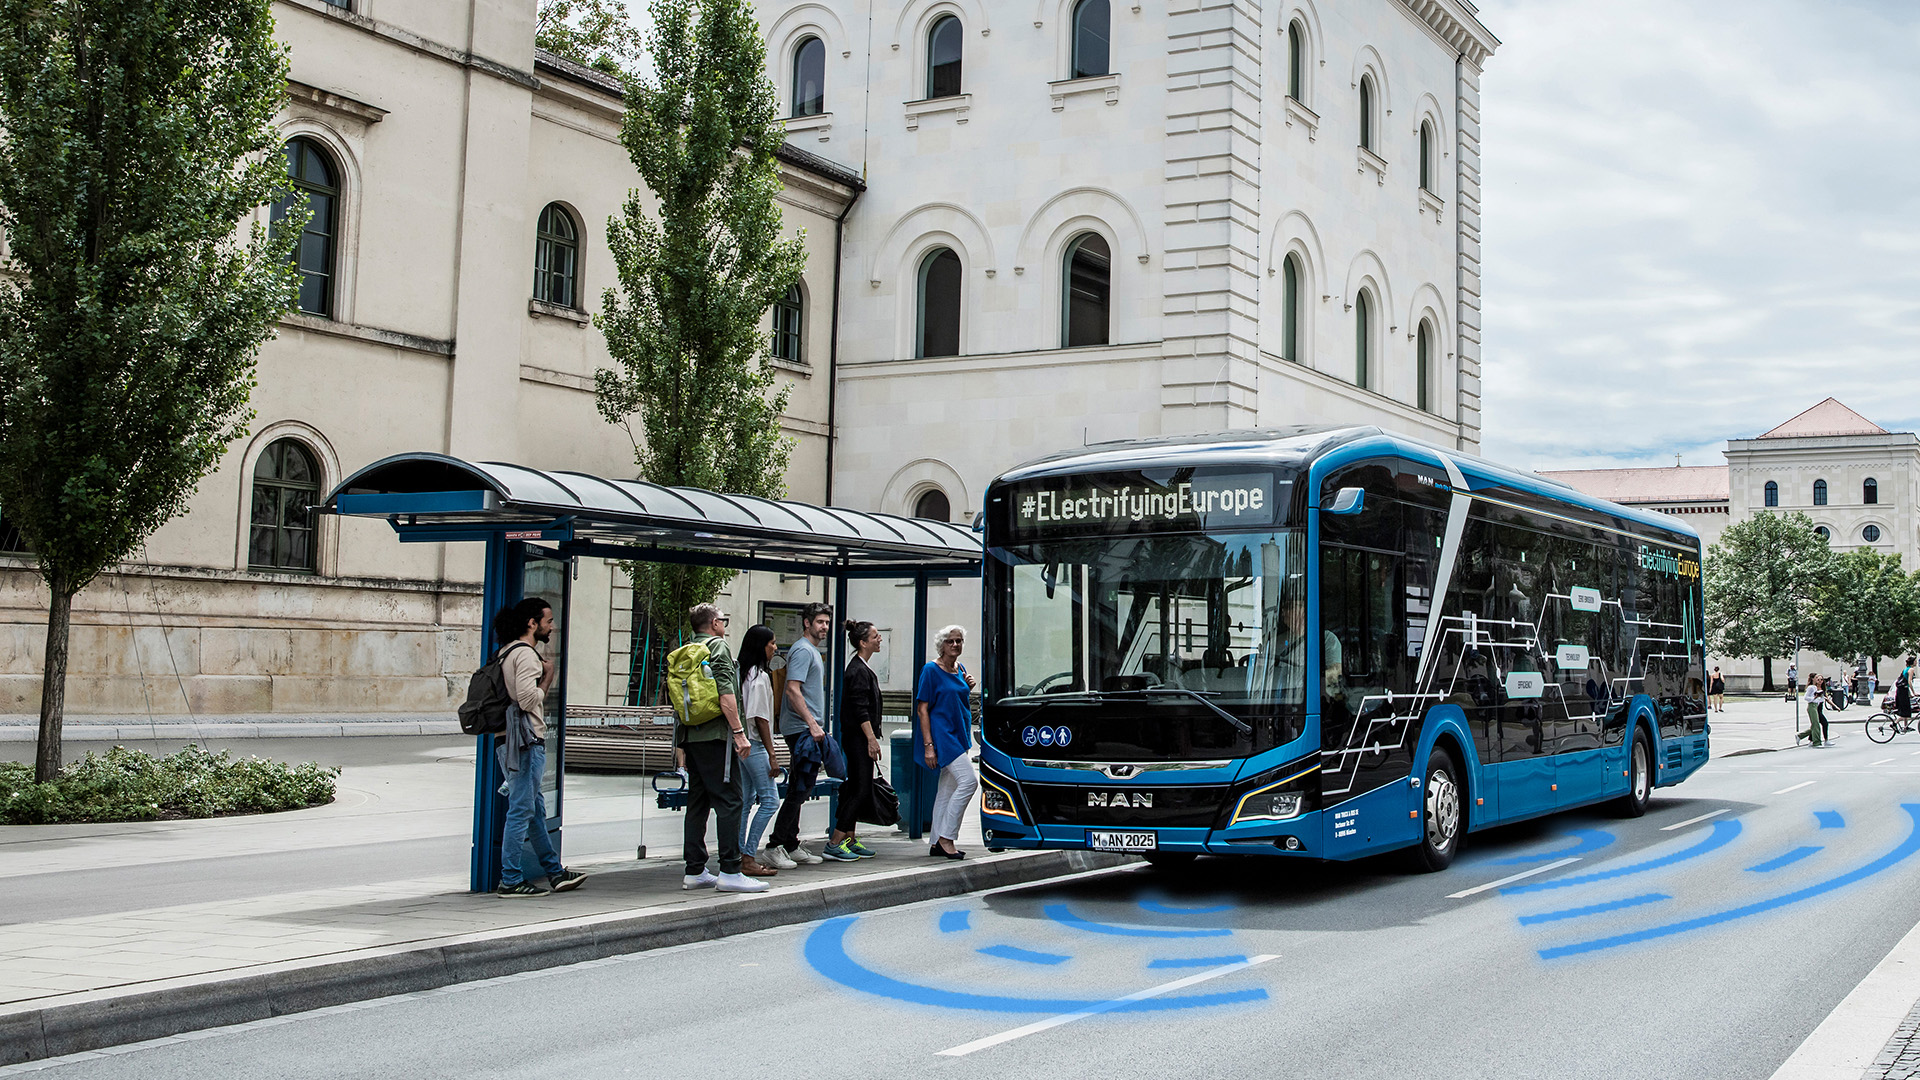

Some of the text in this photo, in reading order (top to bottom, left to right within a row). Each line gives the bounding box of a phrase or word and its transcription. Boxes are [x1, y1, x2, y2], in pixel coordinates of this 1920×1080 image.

[1417, 474, 1434, 487] MAN
[1020, 482, 1264, 522] #ElectrifyingEurope
[1087, 792, 1153, 808] MAN
[1125, 834, 1154, 847] 2025
